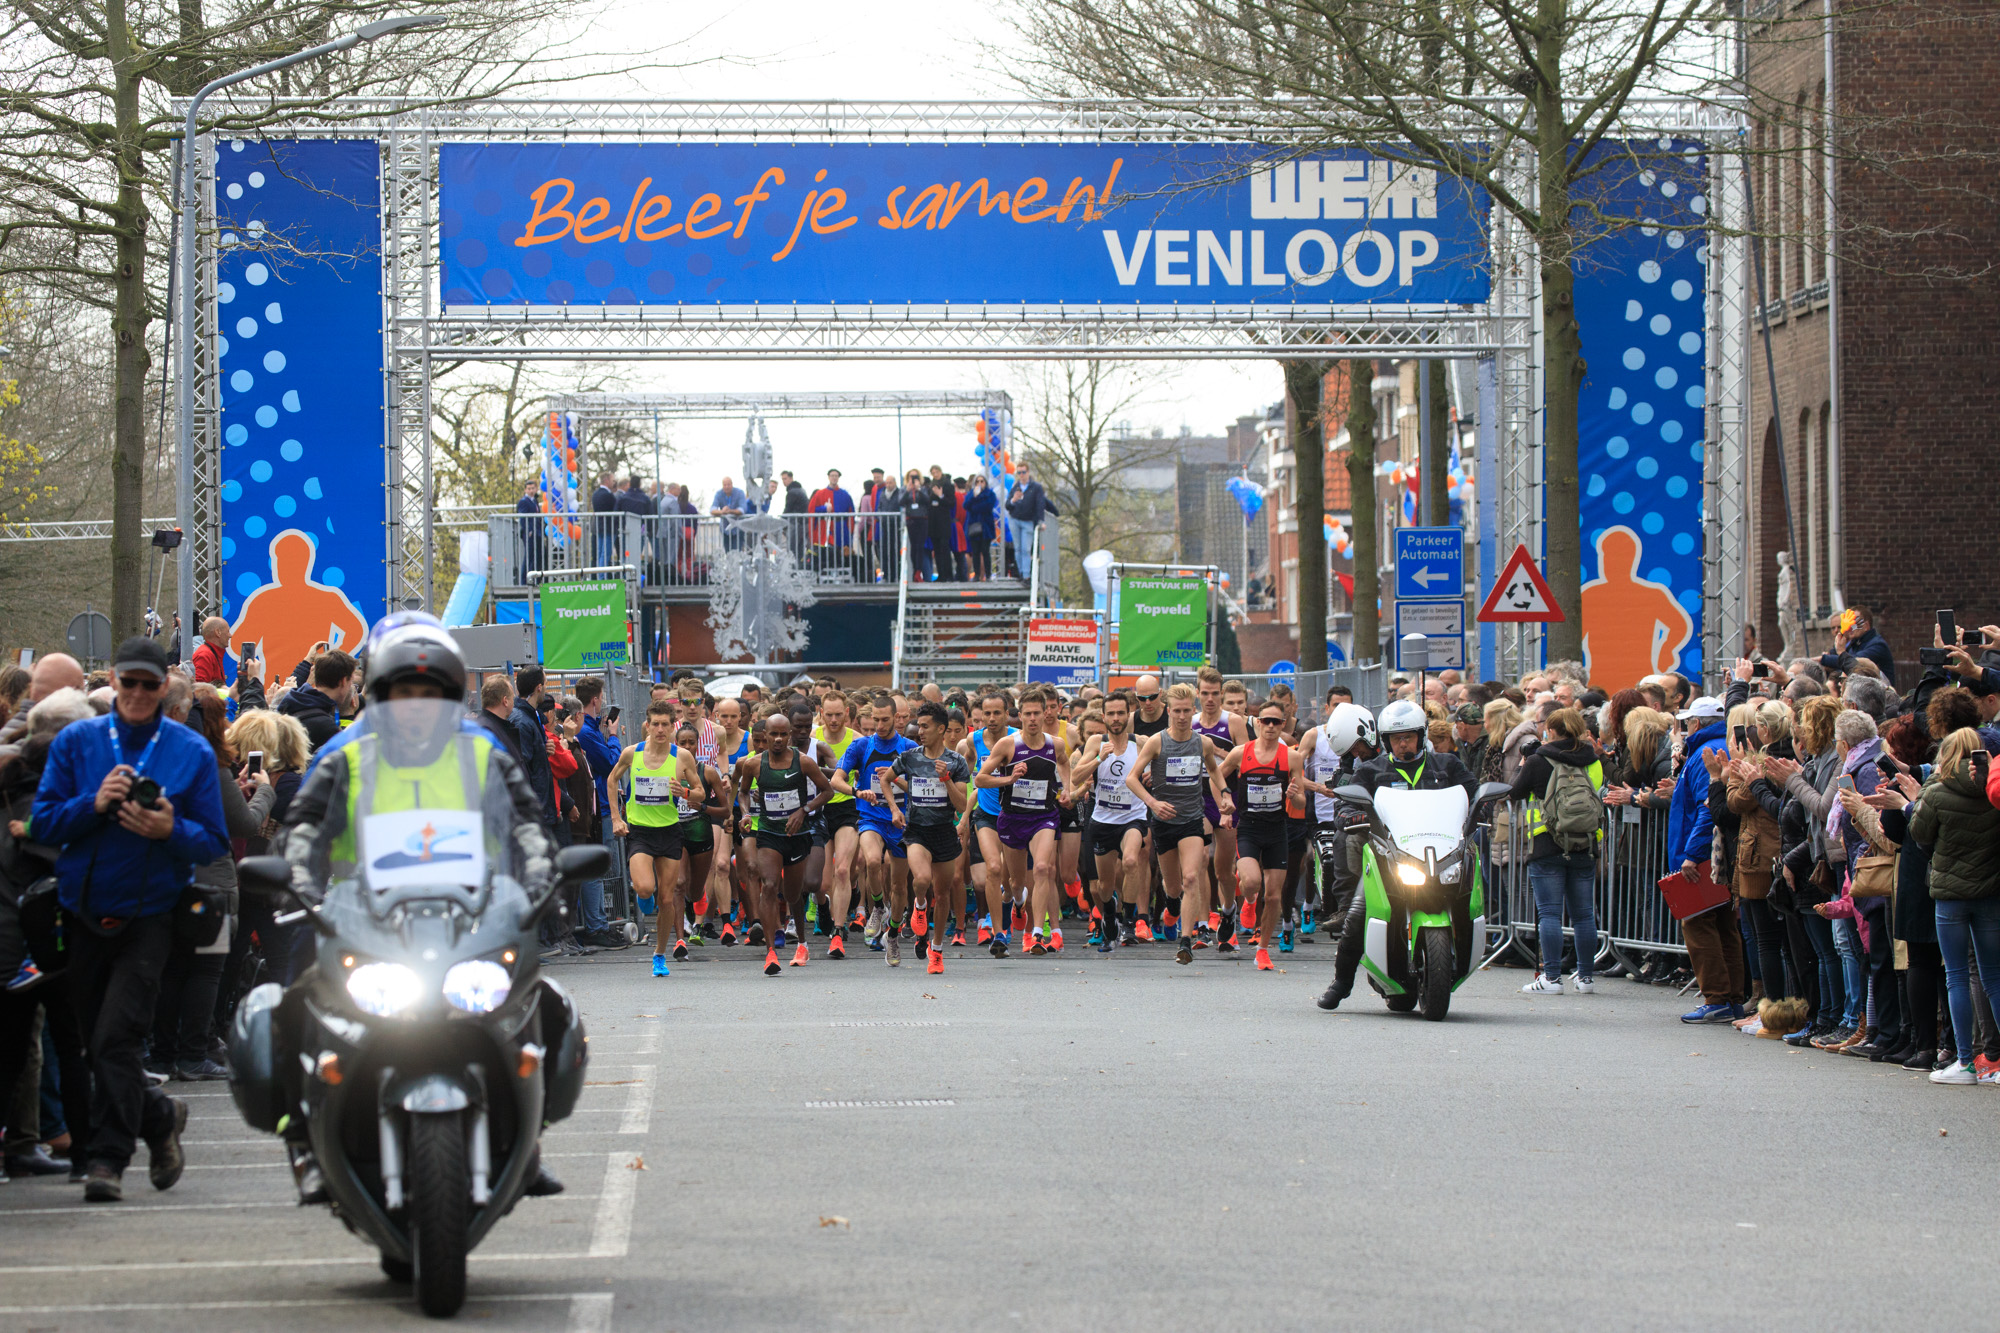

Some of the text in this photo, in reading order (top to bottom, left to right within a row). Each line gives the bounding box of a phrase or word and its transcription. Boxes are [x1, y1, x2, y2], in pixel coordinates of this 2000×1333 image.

[514, 157, 1124, 262] Beleef je samen!
[1102, 229, 1440, 287] VENLOOP
[1407, 535, 1454, 546] Parkeer
[1400, 549, 1460, 560] Automaat
[548, 583, 617, 594] STARTVAK HM
[1129, 581, 1199, 590] STARTVAK HM
[556, 604, 611, 620] Topveld
[1135, 603, 1191, 617] Topveld
[1038, 624, 1089, 632] NEDERLANDS
[1030, 630, 1096, 638] KAMPIOENSCHAP
[1045, 645, 1082, 654] HALVE
[581, 650, 626, 660] VENLOOP
[1030, 654, 1095, 663] MARATHON
[1156, 650, 1203, 659] VENLOOP
[648, 787, 654, 795] 7
[921, 788, 935, 796] 111
[1027, 790, 1031, 798] 1
[1108, 794, 1121, 802] 110
